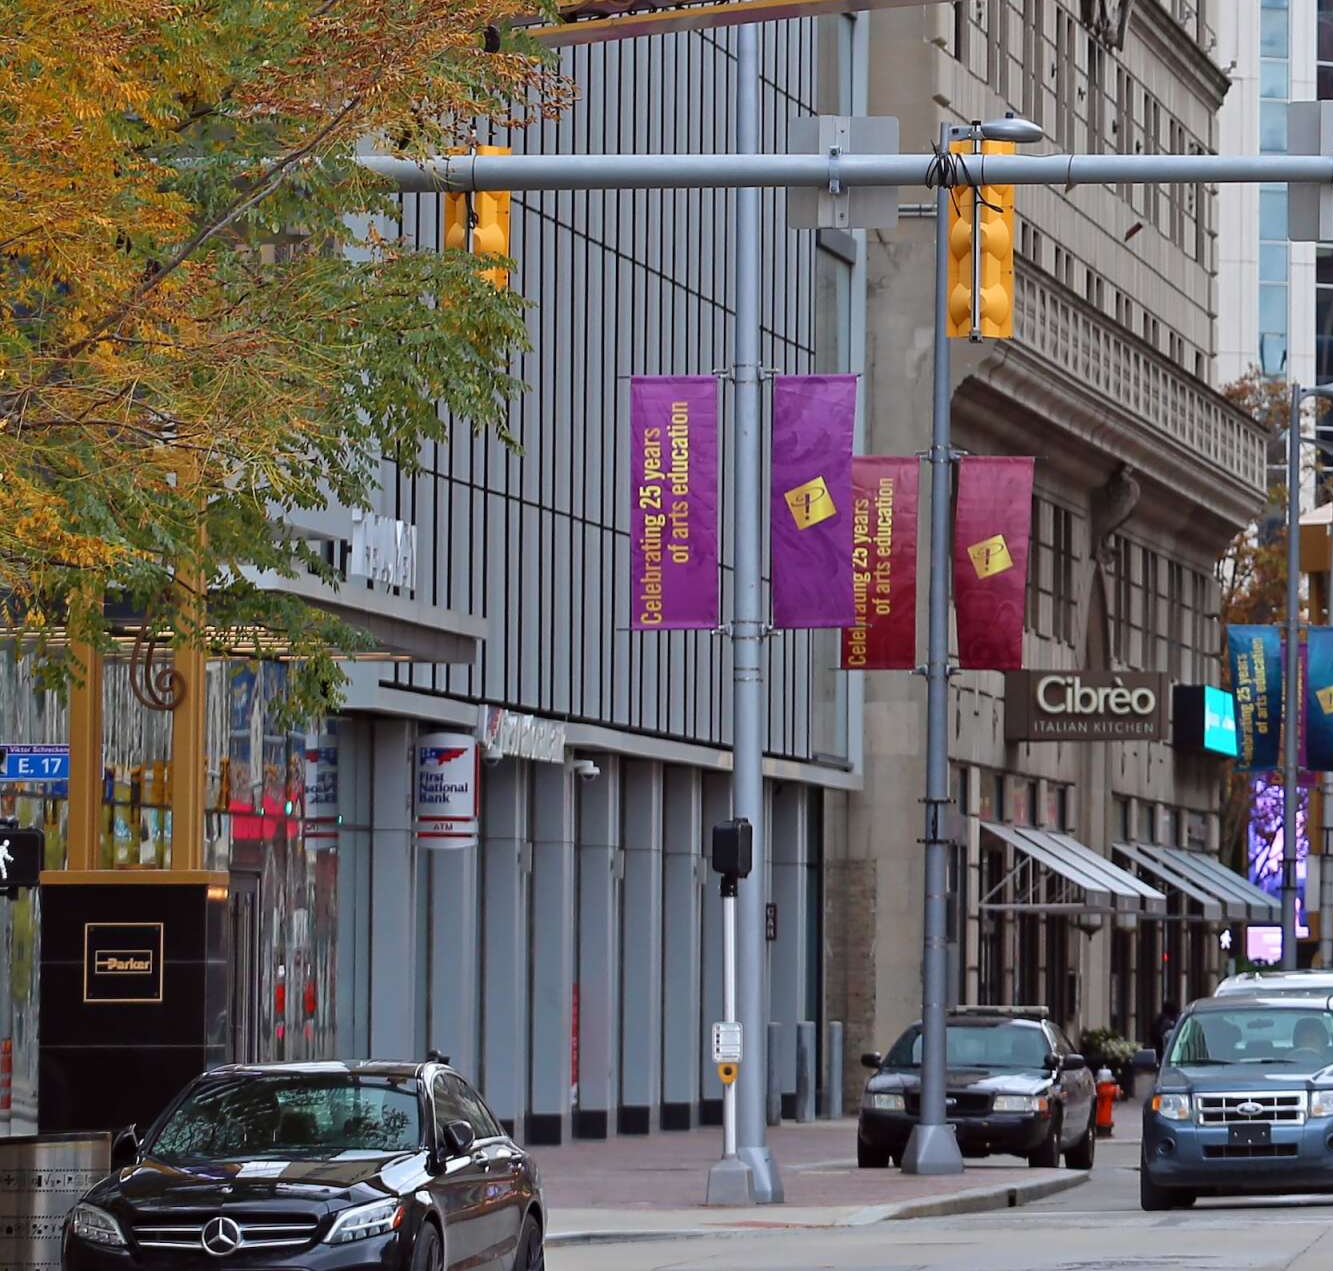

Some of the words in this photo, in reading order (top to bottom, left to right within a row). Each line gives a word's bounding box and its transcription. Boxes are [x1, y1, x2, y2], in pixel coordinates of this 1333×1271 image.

[643, 426, 666, 481] years
[666, 400, 689, 496] education
[639, 485, 662, 509] 25
[668, 500, 689, 532] arts
[853, 497, 872, 543] years
[873, 477, 894, 557] education
[666, 543, 689, 564] of
[640, 510, 666, 625] Celebrating
[873, 560, 891, 594] arts
[871, 598, 891, 615] of
[1036, 675, 1156, 715] Cibrèo
[1034, 721, 1088, 733] ITALIAN
[1093, 721, 1154, 733] KITCHEN
[18, 757, 34, 774] E.
[41, 757, 62, 774] 17
[418, 771, 444, 782] First
[418, 781, 469, 793] National
[418, 792, 451, 804] Bank
[434, 823, 454, 831] ATM
[108, 957, 150, 970] Parker
